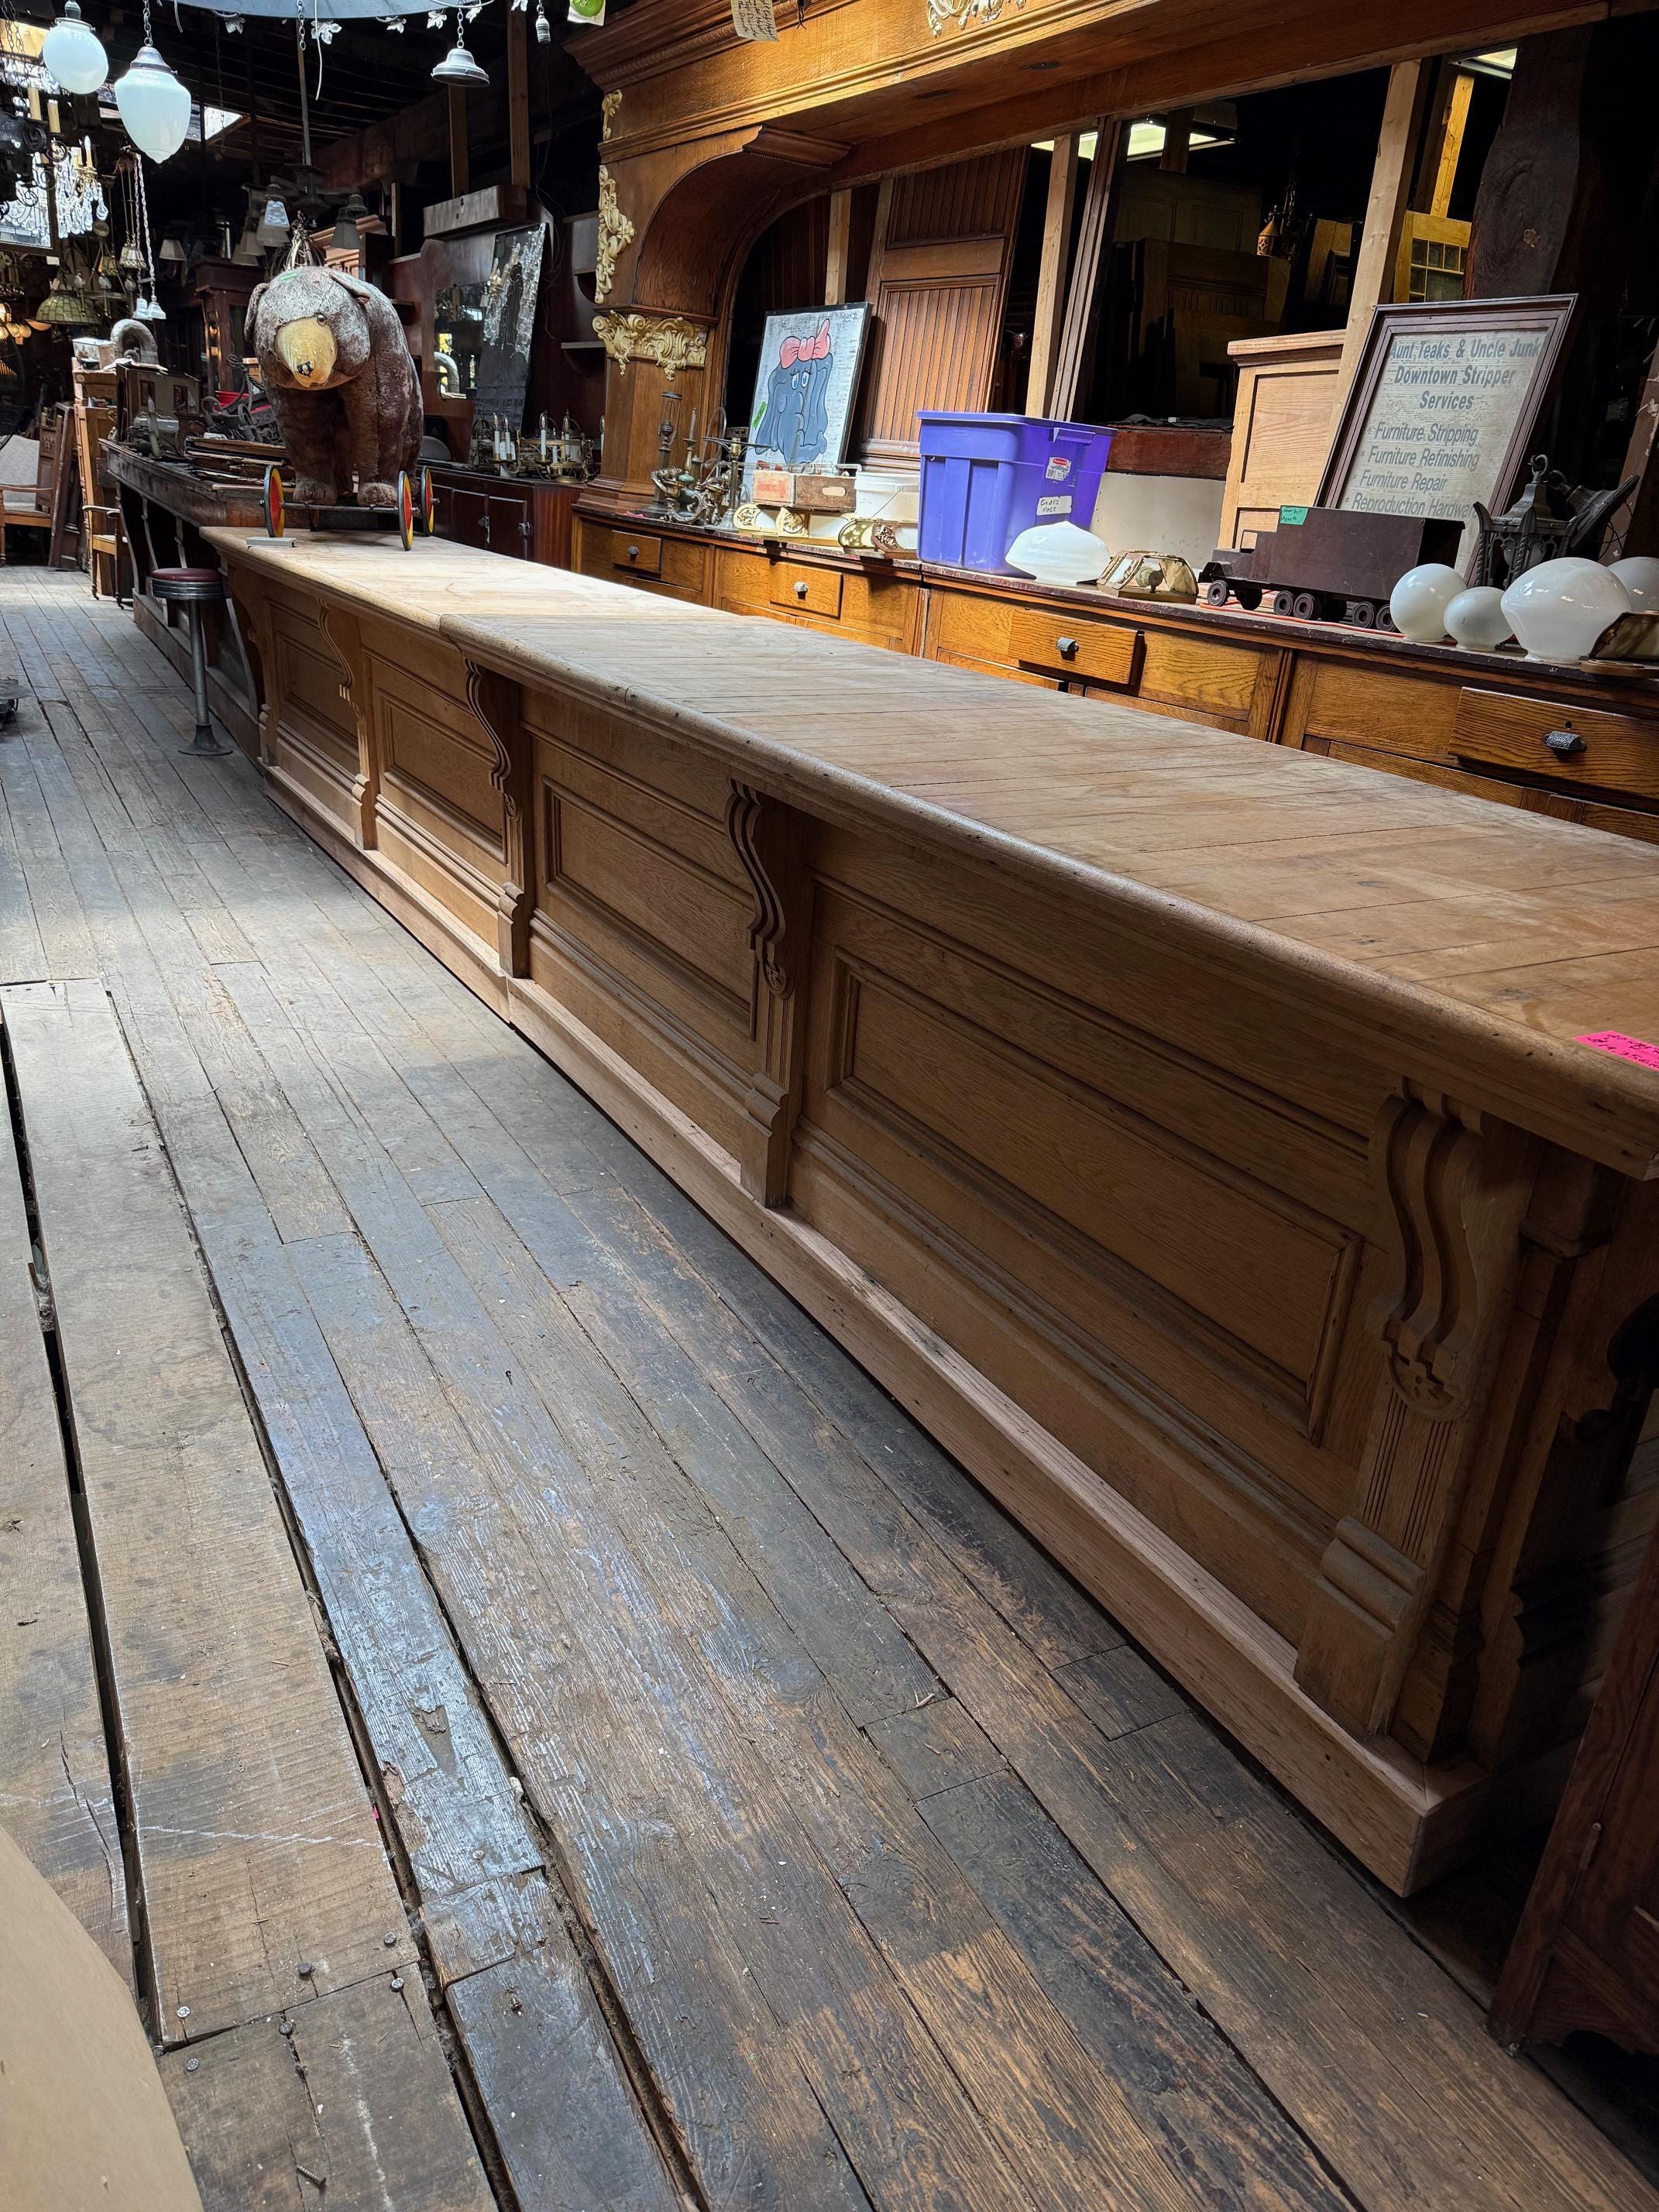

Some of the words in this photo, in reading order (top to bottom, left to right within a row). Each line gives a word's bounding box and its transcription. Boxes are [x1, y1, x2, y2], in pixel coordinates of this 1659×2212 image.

[1390, 341, 1413, 359] Aunt
[1418, 340, 1451, 359] Teaks
[1456, 338, 1466, 358] &
[1471, 338, 1506, 358] Uncle
[1510, 338, 1541, 357] Junk
[1394, 366, 1458, 384] Downtown
[1462, 365, 1516, 387] Stripper
[1419, 390, 1475, 410] Services
[1375, 421, 1424, 441] Furniture
[1427, 423, 1479, 447] Stripping
[1368, 445, 1417, 465] Furniture
[1420, 448, 1480, 472] Refinishing
[1359, 469, 1408, 489] Furniture
[1410, 472, 1449, 494] Repair
[1352, 492, 1425, 515] Reproduction
